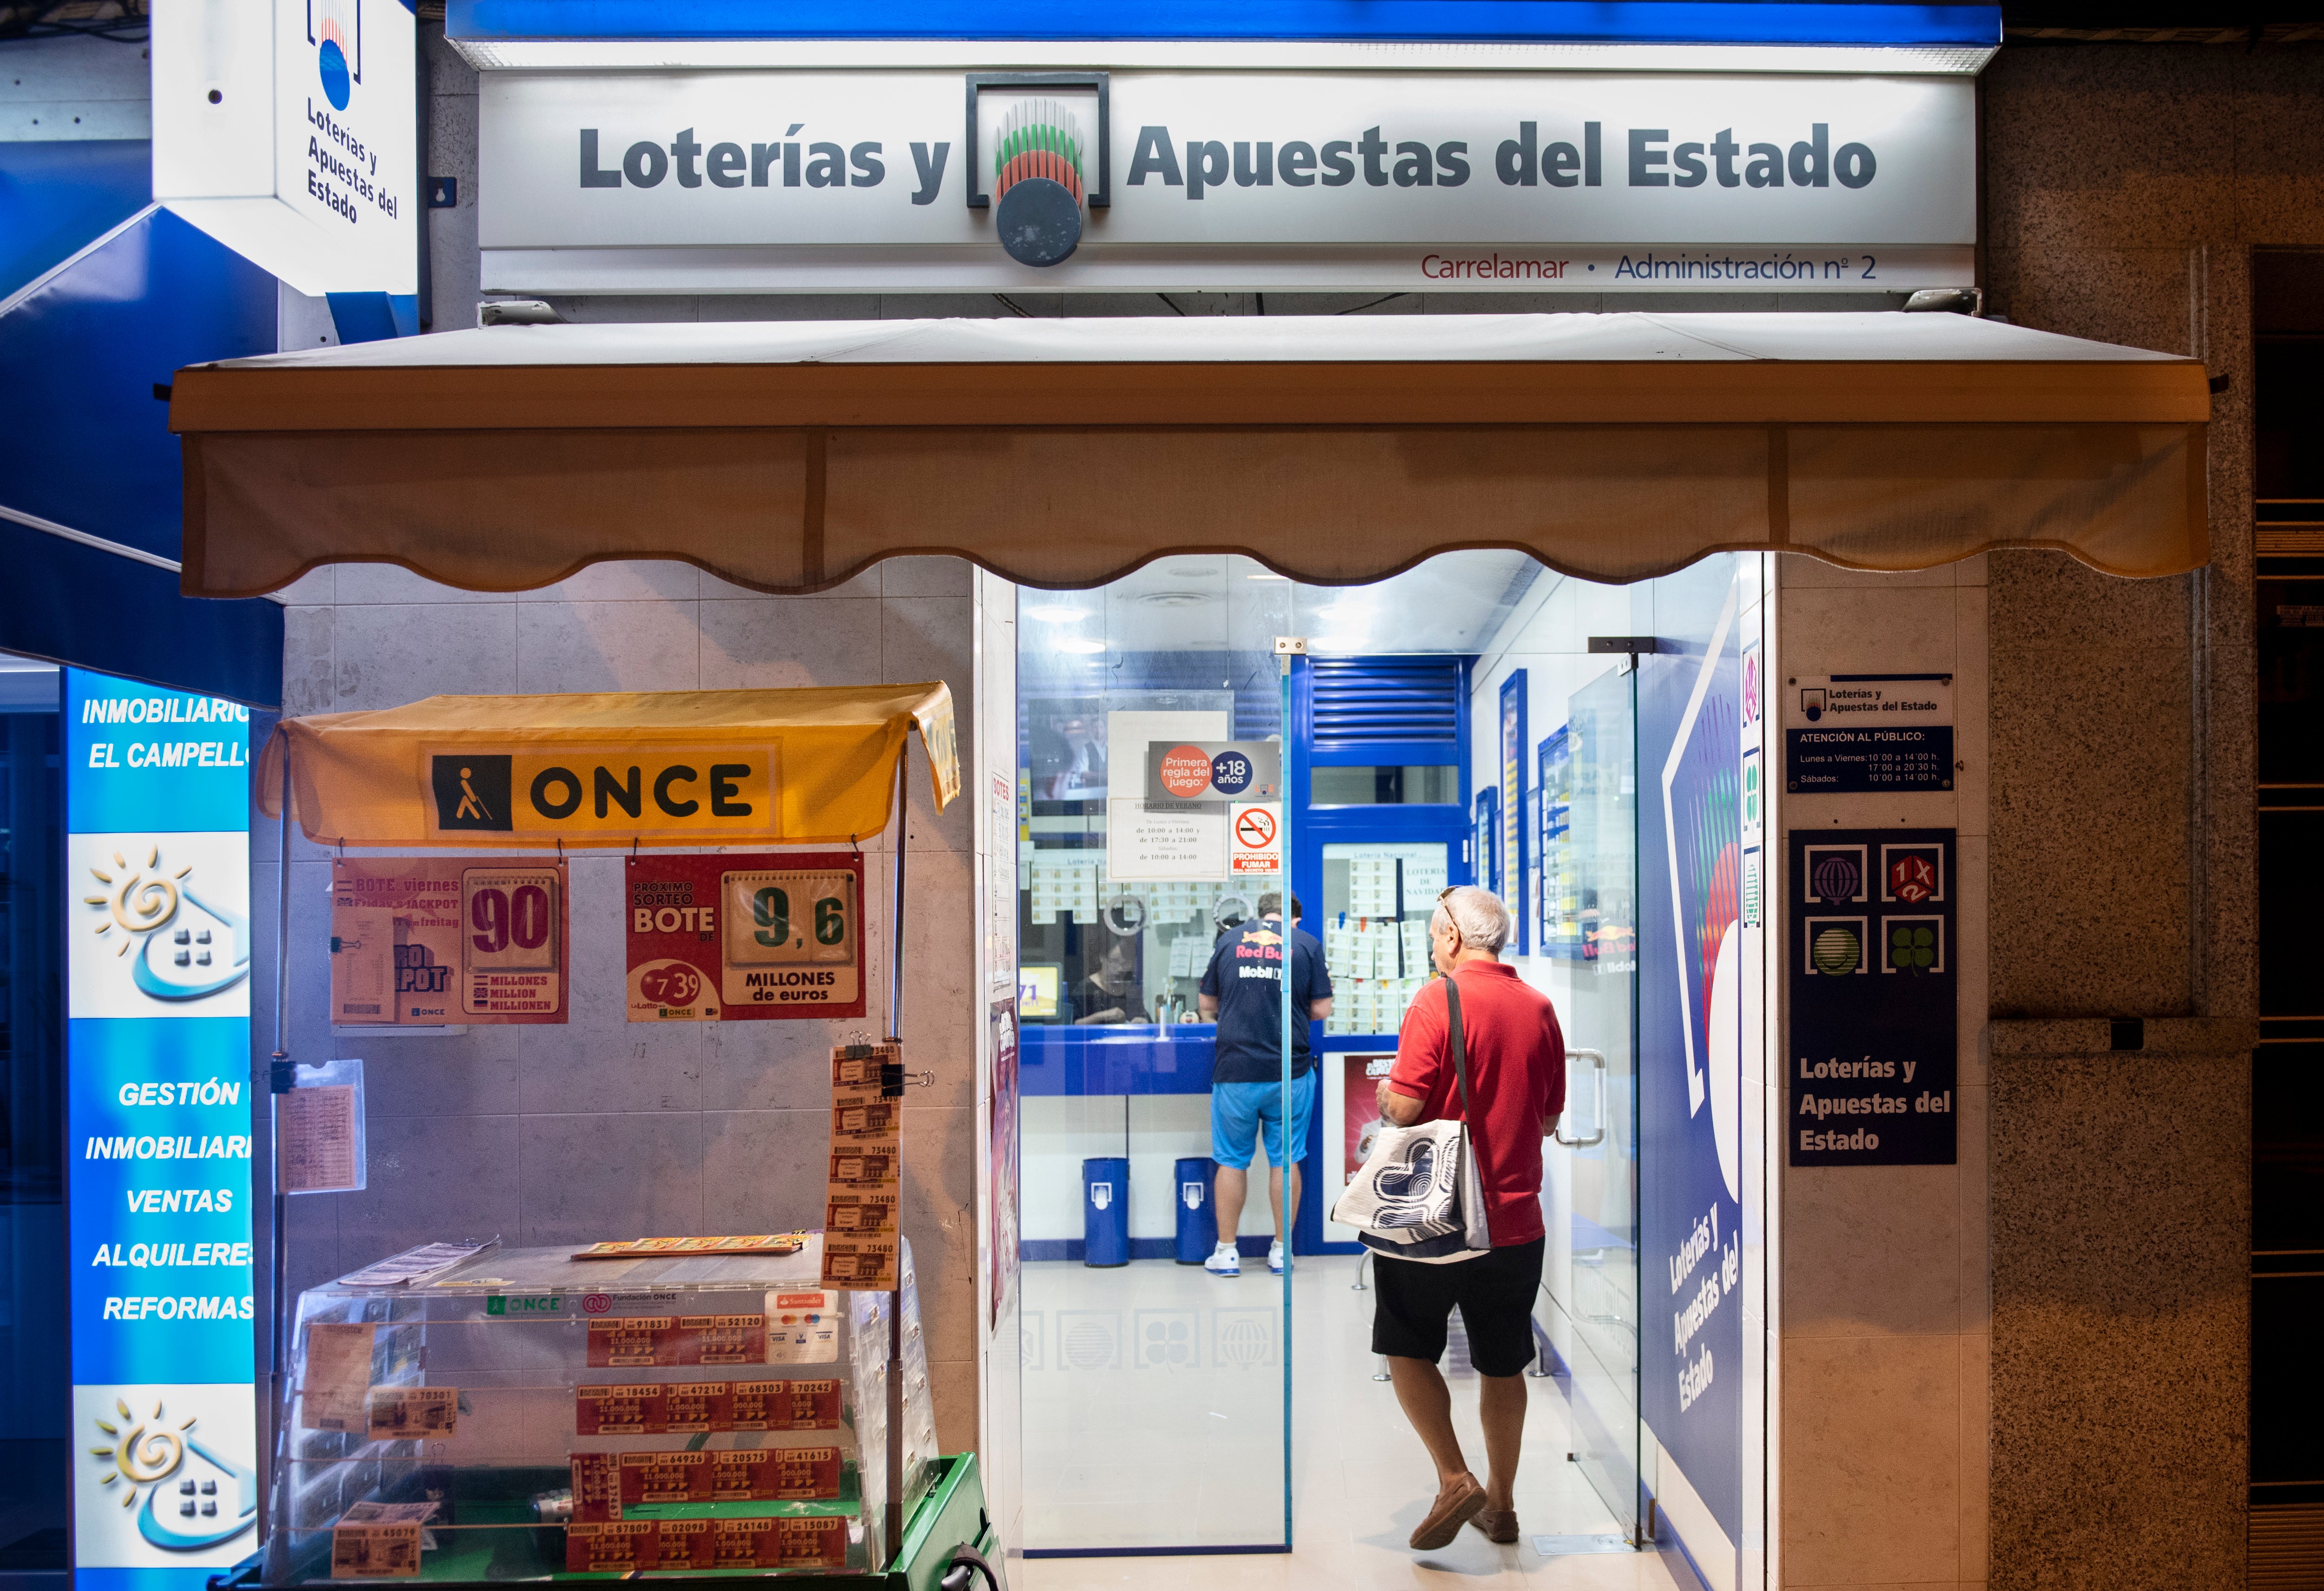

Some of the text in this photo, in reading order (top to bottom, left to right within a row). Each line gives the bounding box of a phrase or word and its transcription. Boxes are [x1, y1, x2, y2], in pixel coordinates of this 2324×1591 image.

[308, 97, 377, 176] Loterías y
[580, 121, 1877, 205] Loterías y Apuestas del Estado
[308, 135, 397, 220] Apuestas del
[308, 169, 357, 224] Estado
[1420, 253, 1570, 279] Carrelamar
[1614, 253, 1819, 280] Administración
[1862, 256, 1876, 279] 2
[1829, 689, 1882, 699] Loterías y
[1829, 701, 1937, 714] Apuestas del Estado
[1800, 730, 1925, 743] ATENCIÓN AL PÚBLICO:
[89, 743, 249, 768] EL CAMPELL
[1165, 757, 1208, 767] Primera
[1163, 767, 1209, 777] regla del
[1216, 760, 1246, 776] +18
[1169, 777, 1203, 788] juego:
[1218, 774, 1243, 784] años
[1801, 774, 1839, 782] Sábados:
[529, 763, 753, 819] ONCE
[993, 777, 1009, 801] BOTES
[356, 878, 459, 892] BOTE viernes
[634, 880, 693, 892] PRÓXIMO
[406, 900, 459, 909] JACKPOT
[634, 893, 693, 906] SORTEO
[421, 917, 459, 928] freitag
[471, 885, 548, 953] 90
[634, 907, 714, 933] BOTE
[699, 933, 714, 942] DE
[1236, 945, 1293, 960] Red Bu
[746, 972, 835, 986] MILLONES
[1239, 966, 1273, 979] Mobil
[490, 977, 548, 986] MILLONES
[490, 989, 536, 998] MILLION
[753, 988, 828, 1001] de euros
[490, 1001, 551, 1010] MILLIONEN
[1800, 1056, 1916, 1083] Loterías y
[119, 1077, 240, 1105] GESTIÓN
[1799, 1091, 1950, 1120] Apuestas del
[1800, 1128, 1879, 1151] Estado
[126, 1189, 233, 1213] VENTAS
[867, 1244, 893, 1253] 73480
[1670, 1202, 1717, 1295] Loterías y
[1674, 1229, 1738, 1359] Apuestas del
[103, 1295, 254, 1320] REFORMAS
[511, 1298, 560, 1311] ONCE
[1678, 1342, 1714, 1413] Estado
[626, 1387, 657, 1396] 18454
[691, 1386, 723, 1394] 47214
[749, 1384, 781, 1393] 68303
[670, 1455, 702, 1463] 64926
[733, 1453, 765, 1462] 20575
[796, 1452, 829, 1460] 41615
[616, 1524, 649, 1533] 87809
[737, 1521, 769, 1530] 24148
[804, 1520, 835, 1529] 15087
